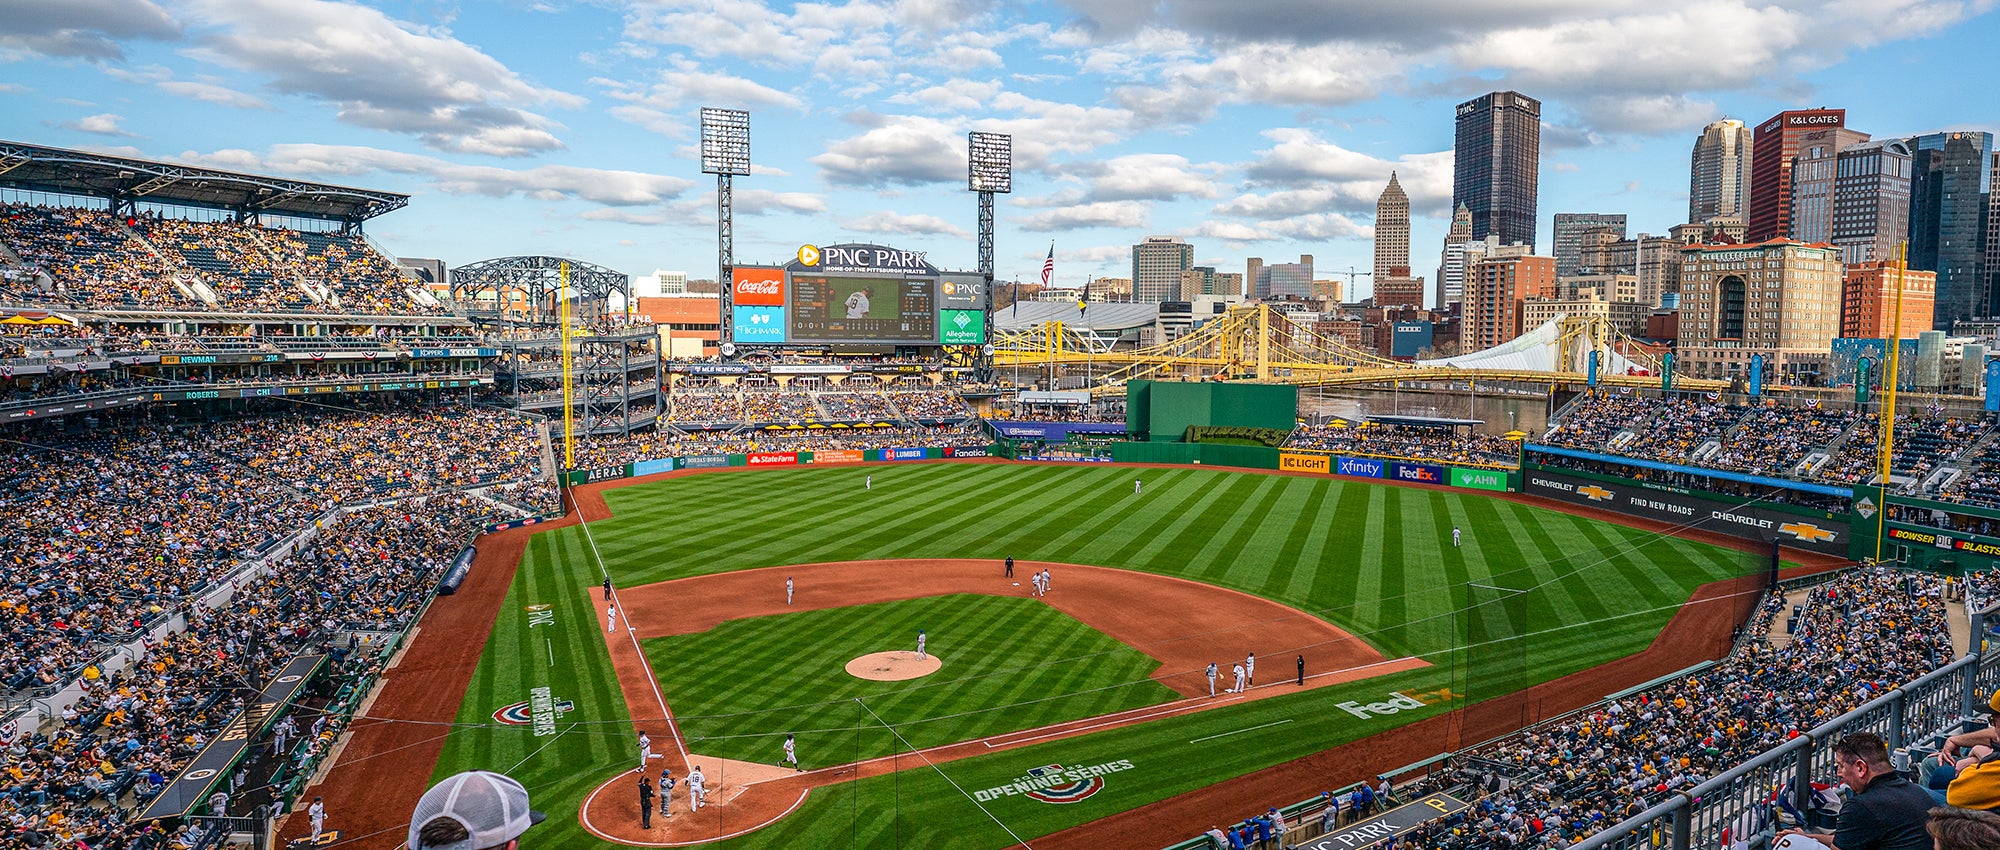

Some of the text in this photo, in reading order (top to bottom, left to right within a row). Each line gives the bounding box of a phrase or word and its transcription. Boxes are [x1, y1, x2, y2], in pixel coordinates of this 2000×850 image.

[1515, 96, 1529, 108] UPMC
[824, 248, 927, 267] PNC PARK
[737, 279, 781, 294] Coca-Cola
[957, 284, 981, 294] PNC
[735, 324, 784, 335] HIGHMARK
[181, 355, 216, 363] NEWMAN
[153, 392, 162, 400] 21
[186, 391, 219, 399] ROBERTS
[955, 449, 986, 457] Fanatics
[1296, 459, 1325, 469] LIGHT
[1341, 460, 1379, 476] xfinity
[588, 466, 624, 480] AERAS
[1474, 475, 1497, 486] AHN
[1532, 478, 1573, 492] CHEVROLET
[1630, 497, 1693, 515] FIND NEW ROADS
[1712, 511, 1773, 529] CHEVROLET
[1896, 530, 1935, 544] BOWSER
[528, 609, 555, 628] PNC
[1334, 688, 1466, 720] FedEx
[973, 759, 1135, 803] OPENING SERIES
[1424, 798, 1448, 813] P
[1334, 818, 1401, 847] PARK
[1776, 838, 1791, 850] P
